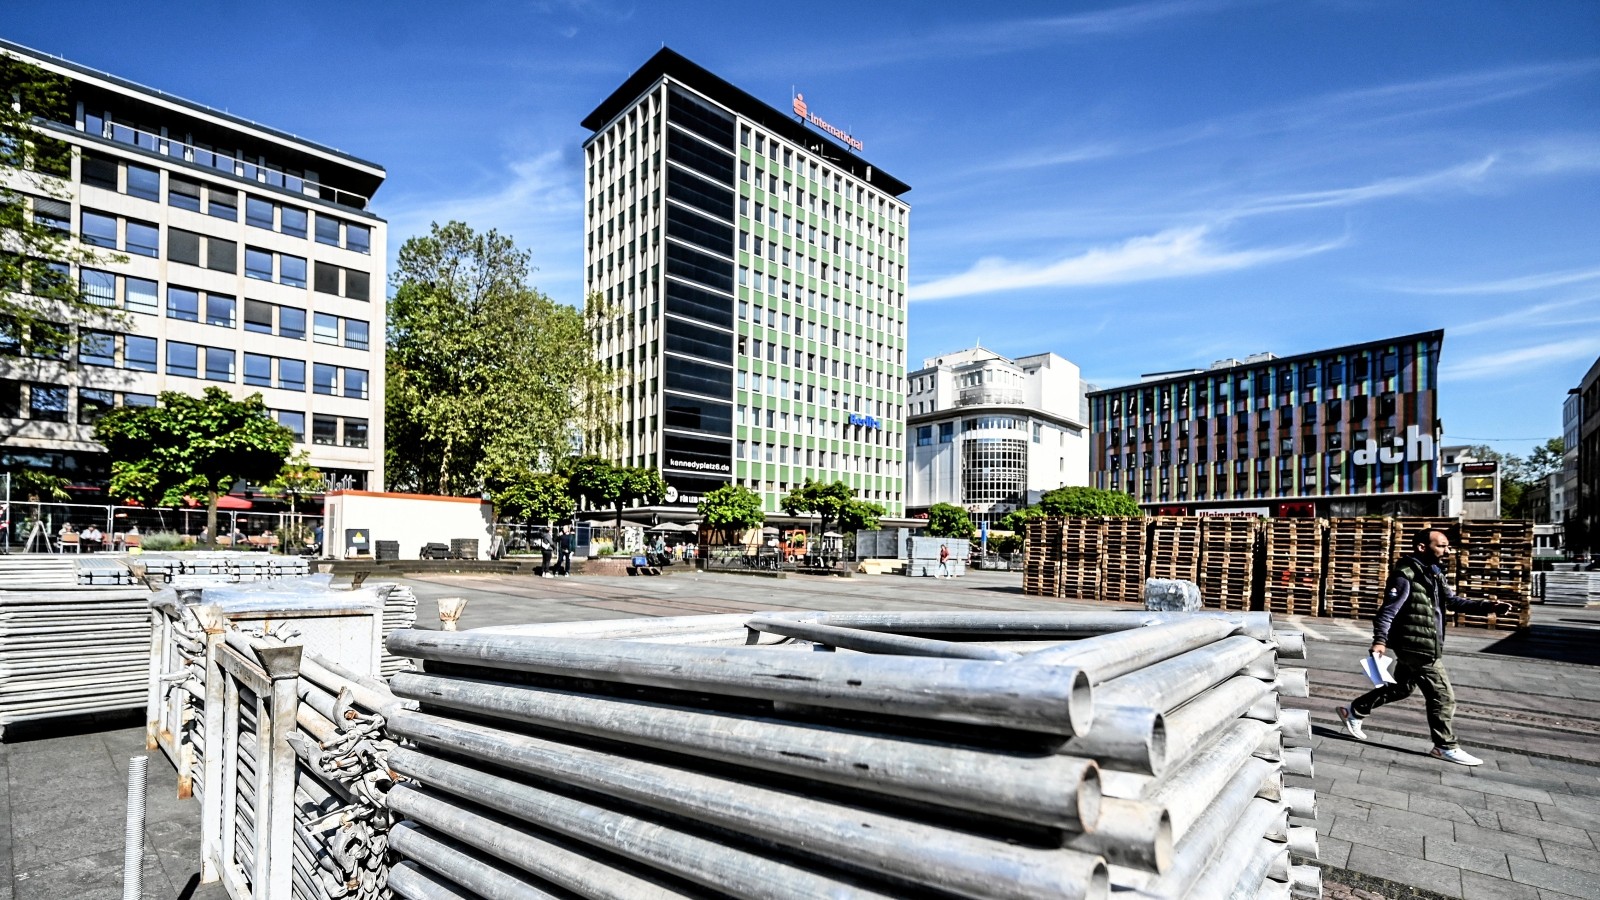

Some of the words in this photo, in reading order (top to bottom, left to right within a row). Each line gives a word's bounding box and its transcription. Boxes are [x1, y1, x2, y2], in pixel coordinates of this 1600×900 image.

[810, 112, 863, 151] International
[670, 458, 730, 471] kennedyplatz6.de
[1353, 425, 1434, 465] dch
